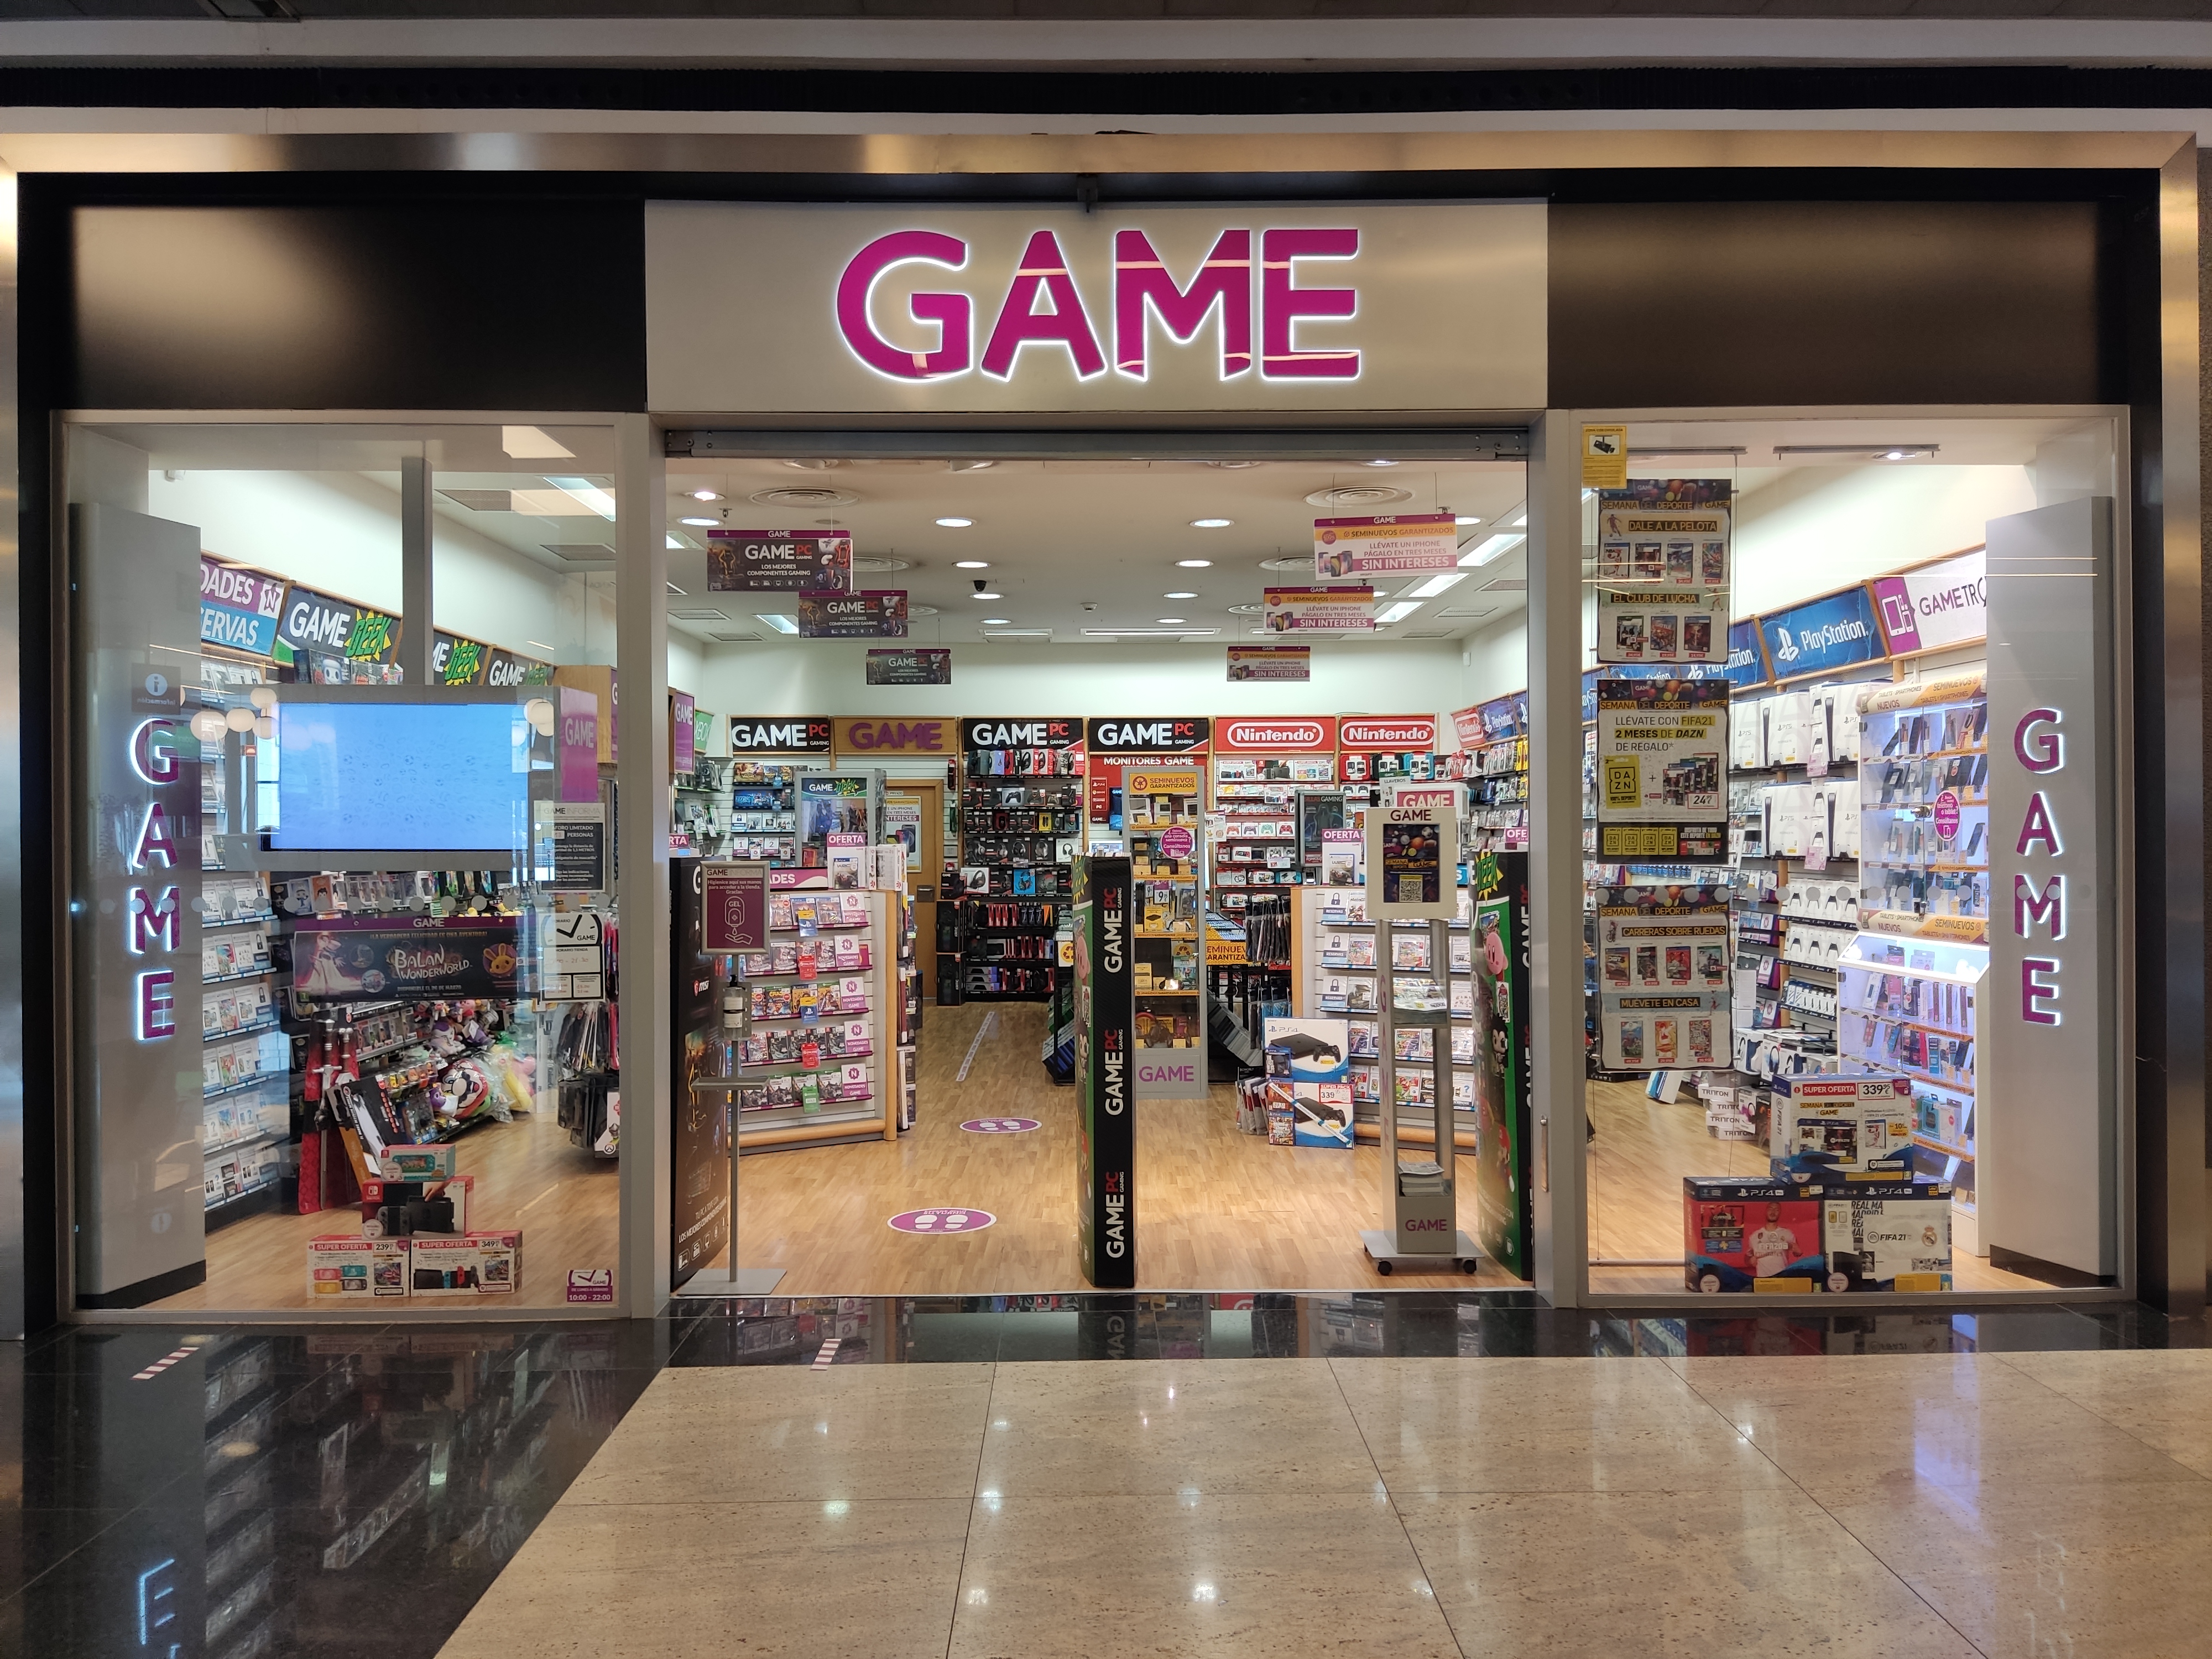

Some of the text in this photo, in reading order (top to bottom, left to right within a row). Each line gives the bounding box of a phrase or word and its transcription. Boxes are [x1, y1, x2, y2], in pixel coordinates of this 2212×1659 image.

[837, 229, 1360, 382] GAME
[1630, 522, 1716, 531] DALE A LA PELOTA
[745, 545, 812, 560] GAME PC
[1362, 556, 1449, 570] SIN INTERESES
[1627, 594, 1650, 603] CLUB
[1666, 594, 1696, 603] LUCHA
[827, 602, 865, 613] GAME
[290, 602, 393, 658] GAME GEEK
[1300, 619, 1316, 627] SIN
[1800, 618, 1869, 653] PlayStation
[889, 658, 917, 666] GAME
[1877, 700, 1900, 710] NUEVOS
[1939, 691, 1969, 701] SMARTPHONES
[676, 703, 692, 725] GAME
[1616, 715, 1712, 725] LLÉVATE CON FIFA21
[1491, 713, 1513, 732] PlayStation
[565, 718, 594, 749] GAME
[732, 723, 828, 747] GAME PC
[849, 722, 943, 750] GAME
[972, 723, 1069, 745] GAME PC
[1098, 723, 1194, 745] GAME PC
[1236, 728, 1314, 741] Nintendo
[1349, 727, 1428, 740] Nintendo
[1676, 729, 1704, 738] DAZN
[1104, 757, 1194, 765] MONITORES GAME
[1403, 794, 1450, 807] GAME
[1390, 810, 1432, 821] GAME
[1477, 853, 1498, 892] GEEK
[2014, 707, 2067, 1026] GAME
[131, 717, 180, 1041] GAME
[413, 919, 445, 927] GAME
[1104, 888, 1122, 974] GAME PC
[1623, 926, 1725, 936] CARRERAS SOBRE RUEDAS
[1879, 922, 1901, 932] NUEVOS
[1942, 933, 1970, 941] SMARTPHONES
[1621, 998, 1661, 1007] MUÉVETE
[1105, 1029, 1123, 1115] GAME PC
[1139, 1066, 1194, 1082] GAME
[1702, 1089, 1729, 1098] TRITTON
[1106, 1171, 1125, 1259] GAME PC
[1405, 1219, 1447, 1231] GAME
